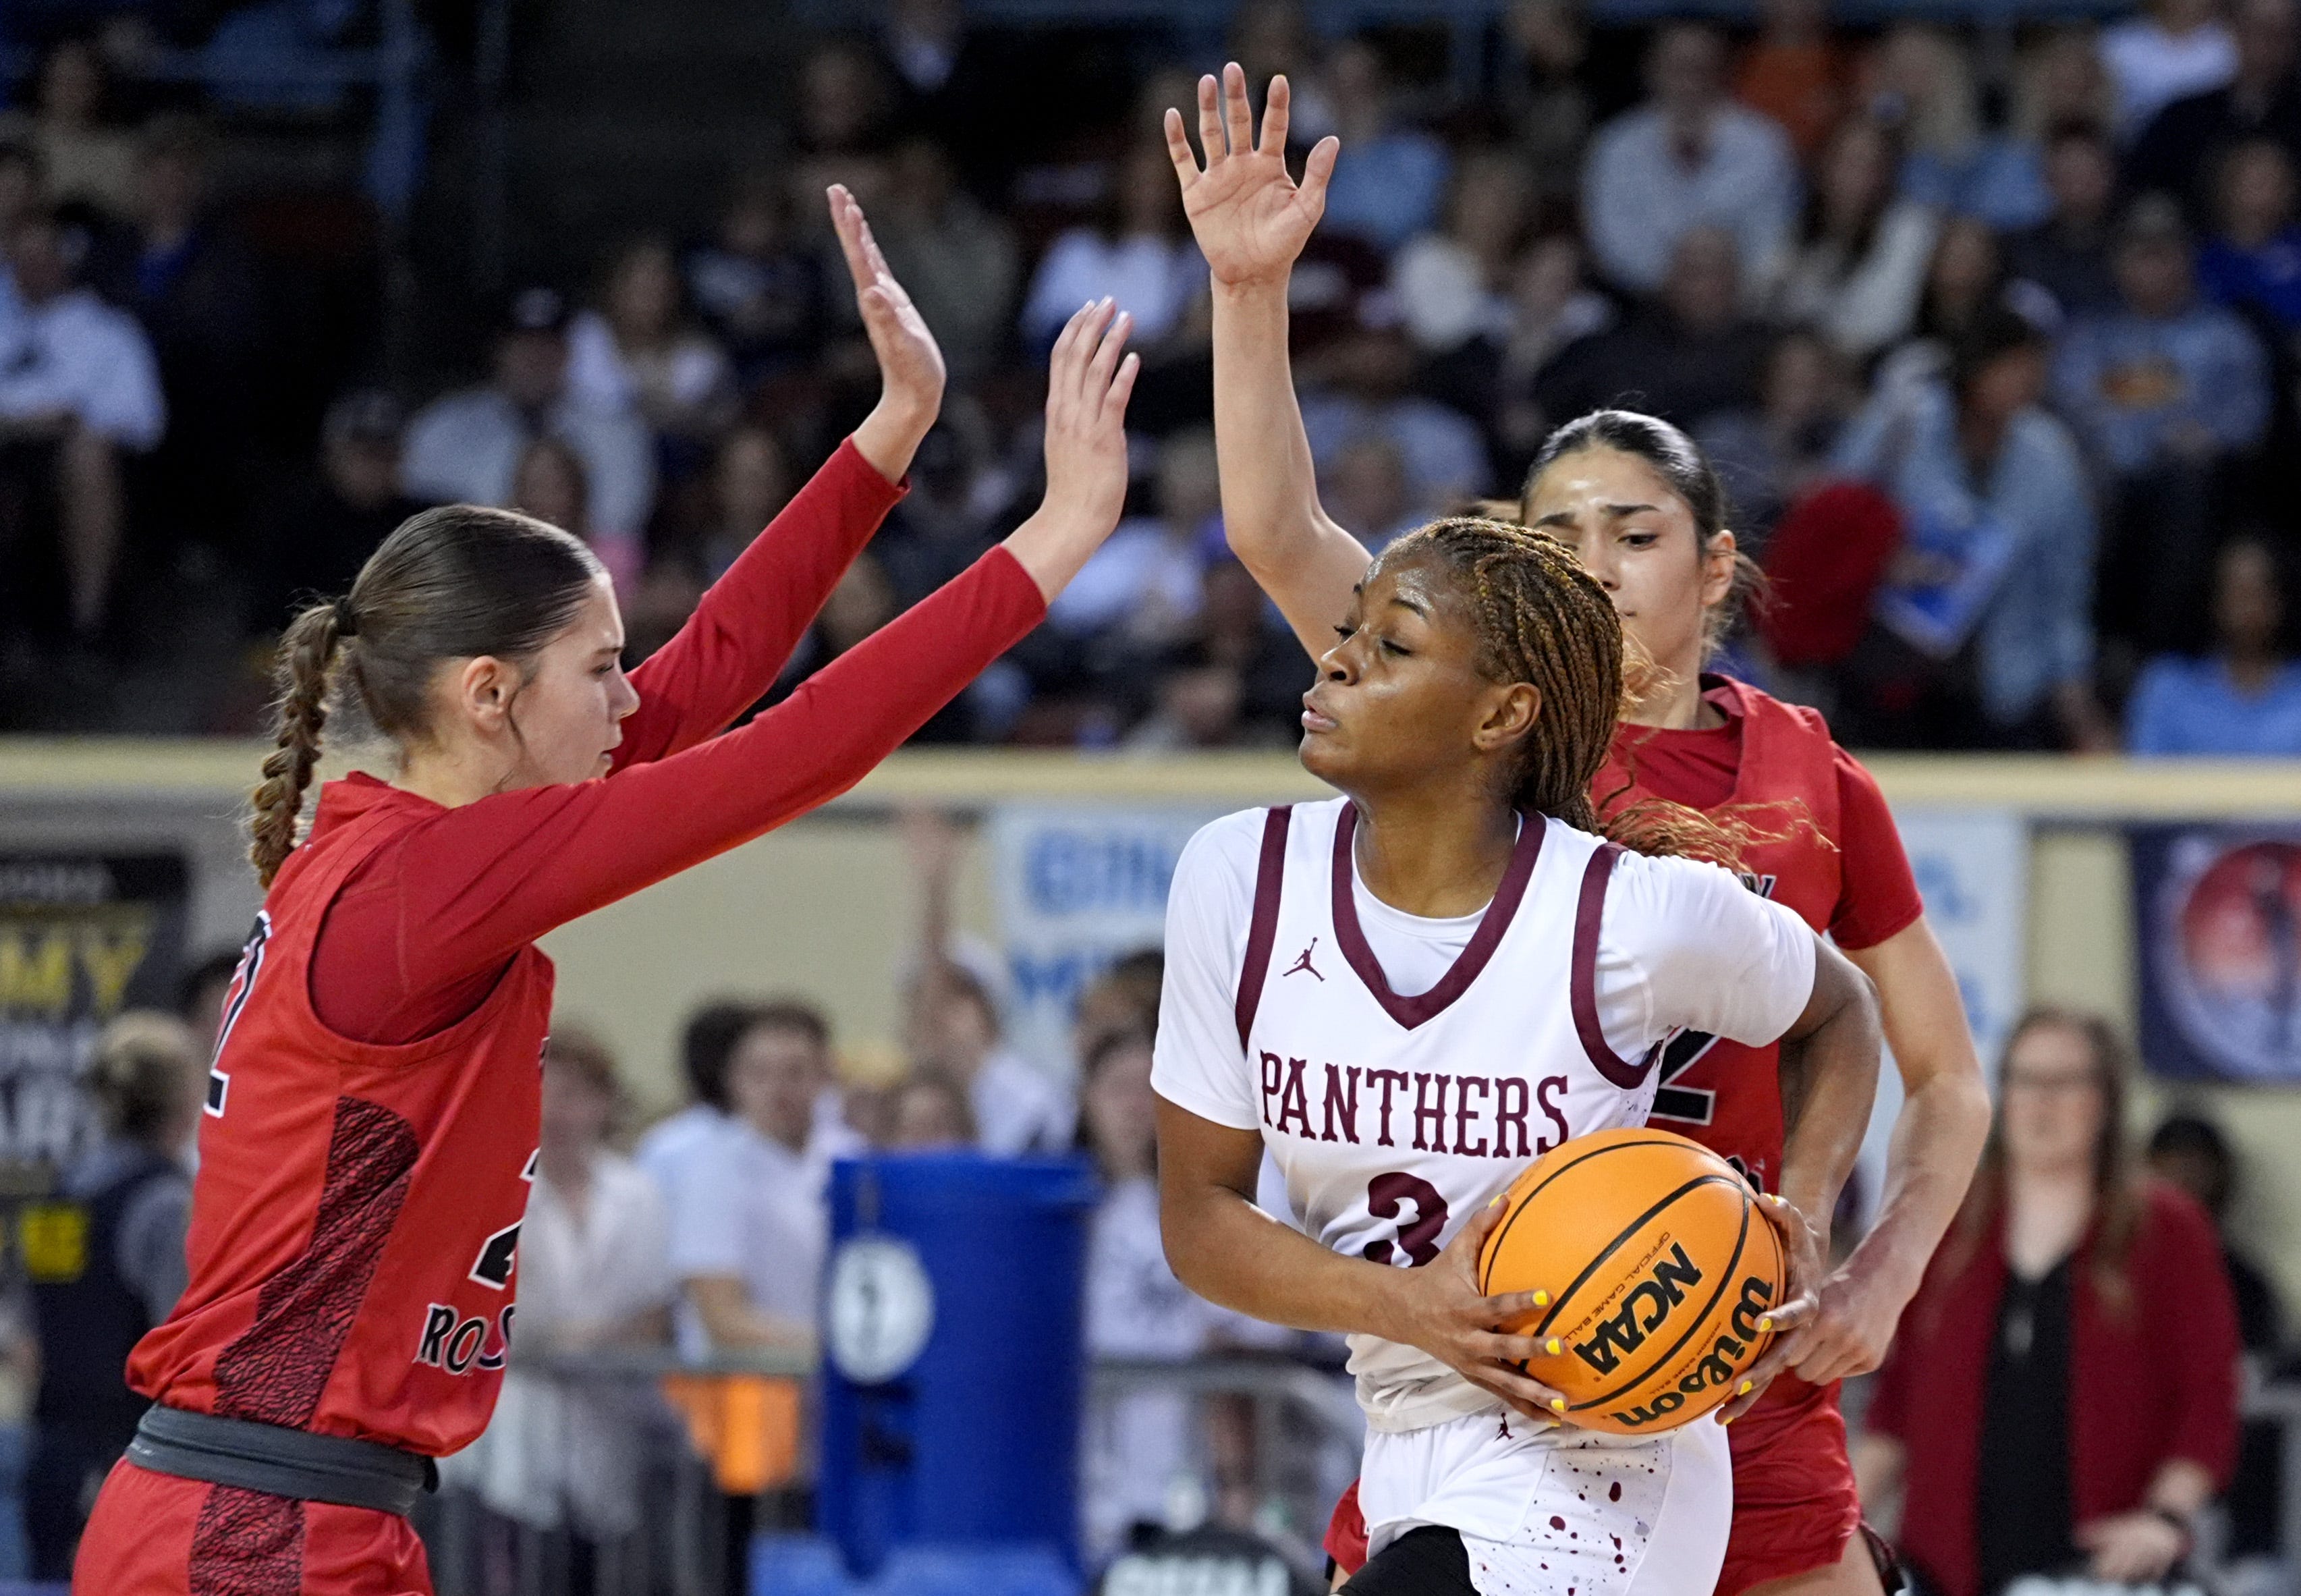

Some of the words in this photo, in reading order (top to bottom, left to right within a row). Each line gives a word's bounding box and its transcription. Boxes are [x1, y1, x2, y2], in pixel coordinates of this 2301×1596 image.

[1260, 1049, 1569, 1158] PANTHERS
[1363, 1172, 1449, 1268] 3
[1624, 1231, 1671, 1281] OFFICIAL
[1562, 1316, 1592, 1342] BALL
[1572, 1241, 1702, 1376] NCAA
[1591, 1283, 1626, 1319] GAME
[1609, 1276, 1773, 1426] Wilson
[1673, 1357, 1696, 1379] GAME
